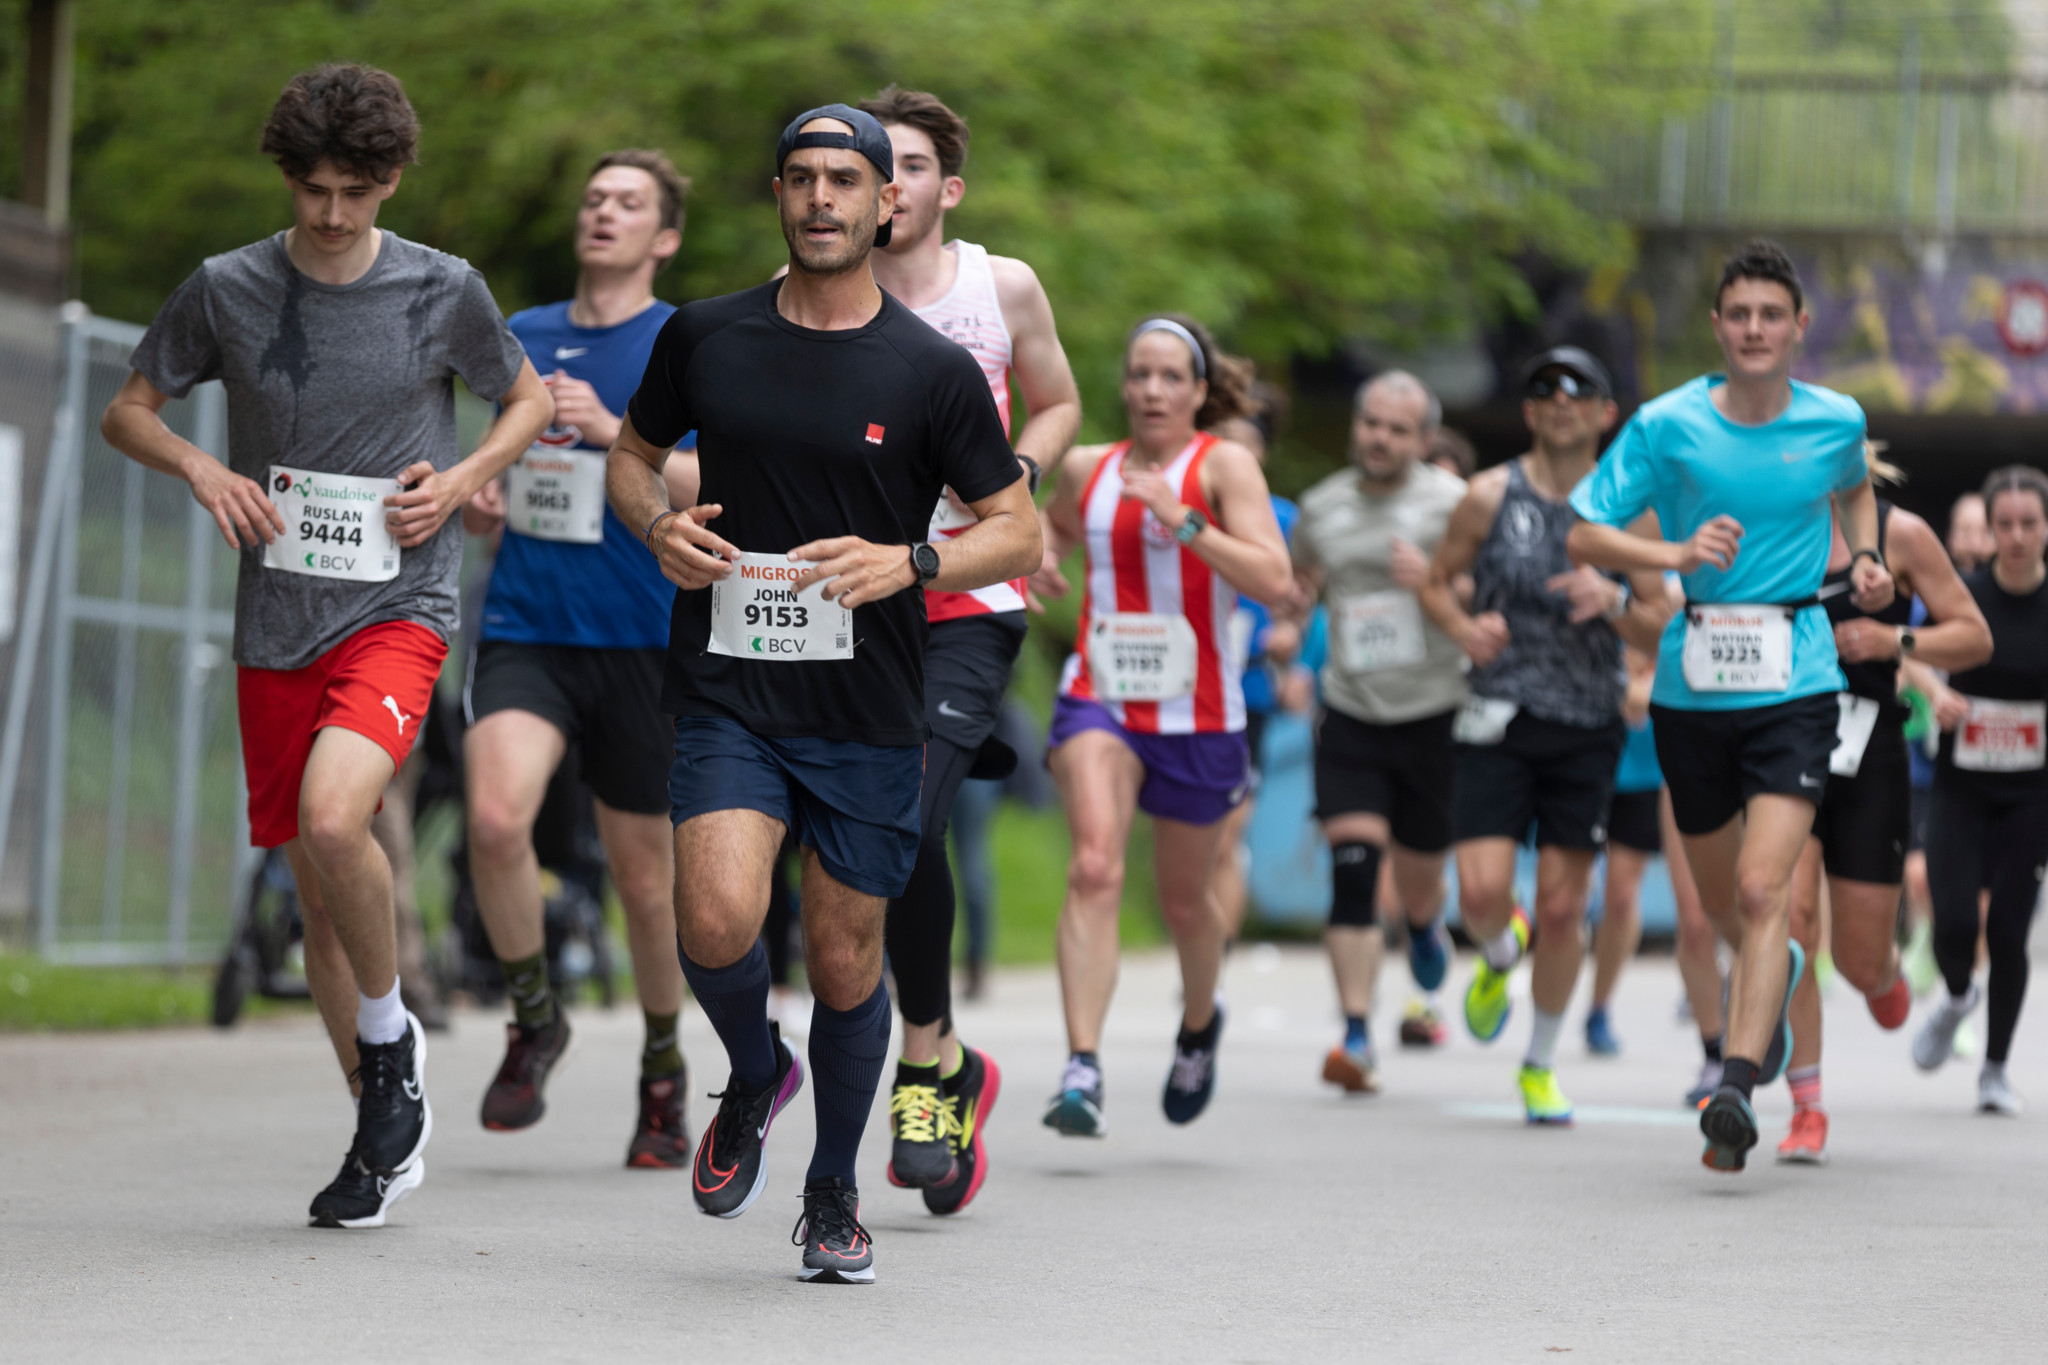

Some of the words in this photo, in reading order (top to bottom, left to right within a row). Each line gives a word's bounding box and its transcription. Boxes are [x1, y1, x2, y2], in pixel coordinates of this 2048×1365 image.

[314, 485, 377, 502] vaudoise
[303, 505, 363, 523] RUSLAN
[300, 521, 363, 547] 9444
[320, 554, 356, 571] BCV
[754, 588, 798, 603] JOHN
[744, 604, 809, 628] 9153
[769, 638, 807, 653] BCV
[1711, 646, 1762, 664] 9225
